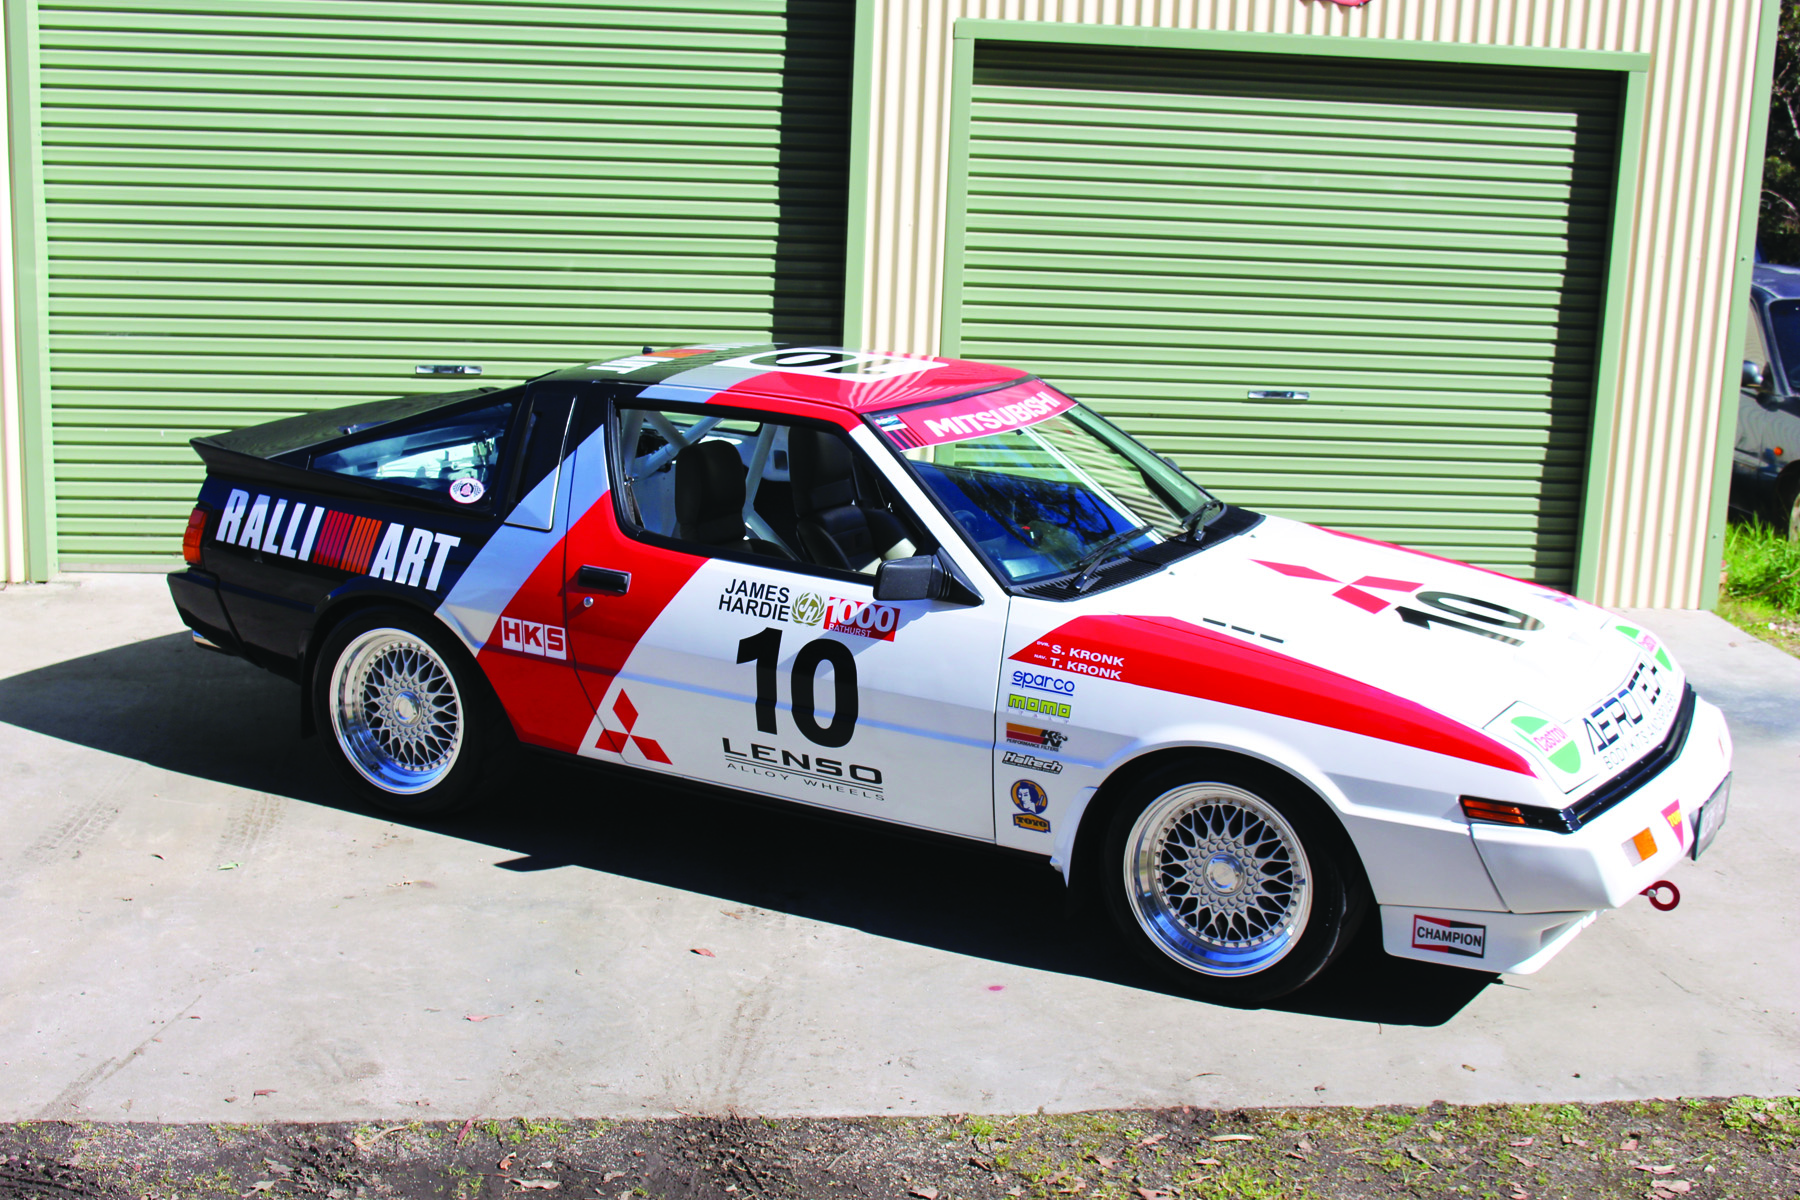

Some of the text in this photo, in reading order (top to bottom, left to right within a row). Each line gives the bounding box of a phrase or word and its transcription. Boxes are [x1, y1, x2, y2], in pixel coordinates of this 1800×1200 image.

[924, 391, 1061, 437] MITSUBISHI
[215, 488, 461, 592] RALLI ART
[725, 578, 790, 604] JAMES
[718, 594, 791, 622] HARDIE
[829, 599, 896, 633] 1000
[1394, 590, 1545, 647] 10
[502, 617, 565, 652] HKS
[829, 623, 872, 638] BATHURST
[1049, 657, 1063, 669] T.
[1066, 660, 1122, 680] KRONK
[1051, 644, 1066, 656] S.
[1069, 647, 1125, 668] KRONK
[736, 627, 859, 748] 10
[1012, 670, 1076, 693] sparco
[1008, 693, 1072, 719] momo
[1006, 738, 1060, 753] PERFORMANCE FILTERS
[1040, 729, 1068, 748] K&N
[1533, 723, 1569, 752] Castrol
[722, 736, 883, 785] LENSO
[1003, 751, 1062, 773] Haltech
[727, 762, 885, 801] ALLOY WHEELS
[1016, 816, 1048, 828] TOYO
[1416, 926, 1482, 947] CHAMPION
